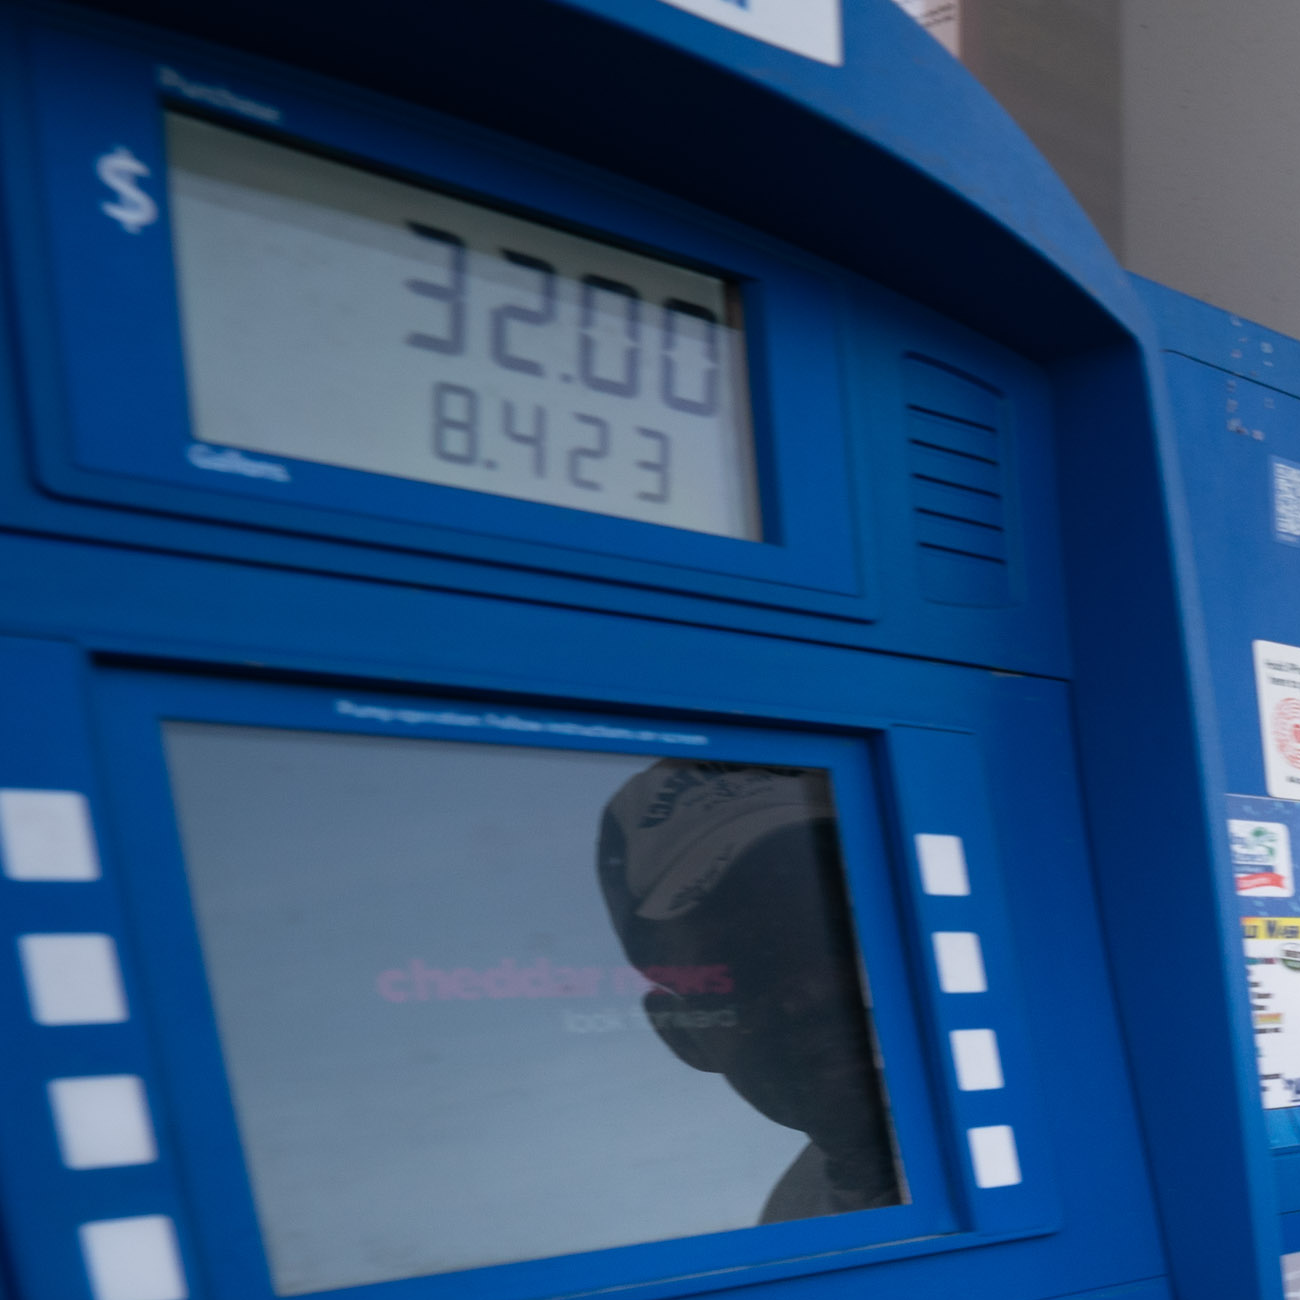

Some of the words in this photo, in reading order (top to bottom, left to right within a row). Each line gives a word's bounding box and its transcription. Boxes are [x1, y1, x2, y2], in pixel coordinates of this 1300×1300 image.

[97, 147, 156, 232] $
[407, 222, 718, 417] 32.00
[433, 382, 668, 504] 8.423
[375, 958, 600, 1002] cheddar
